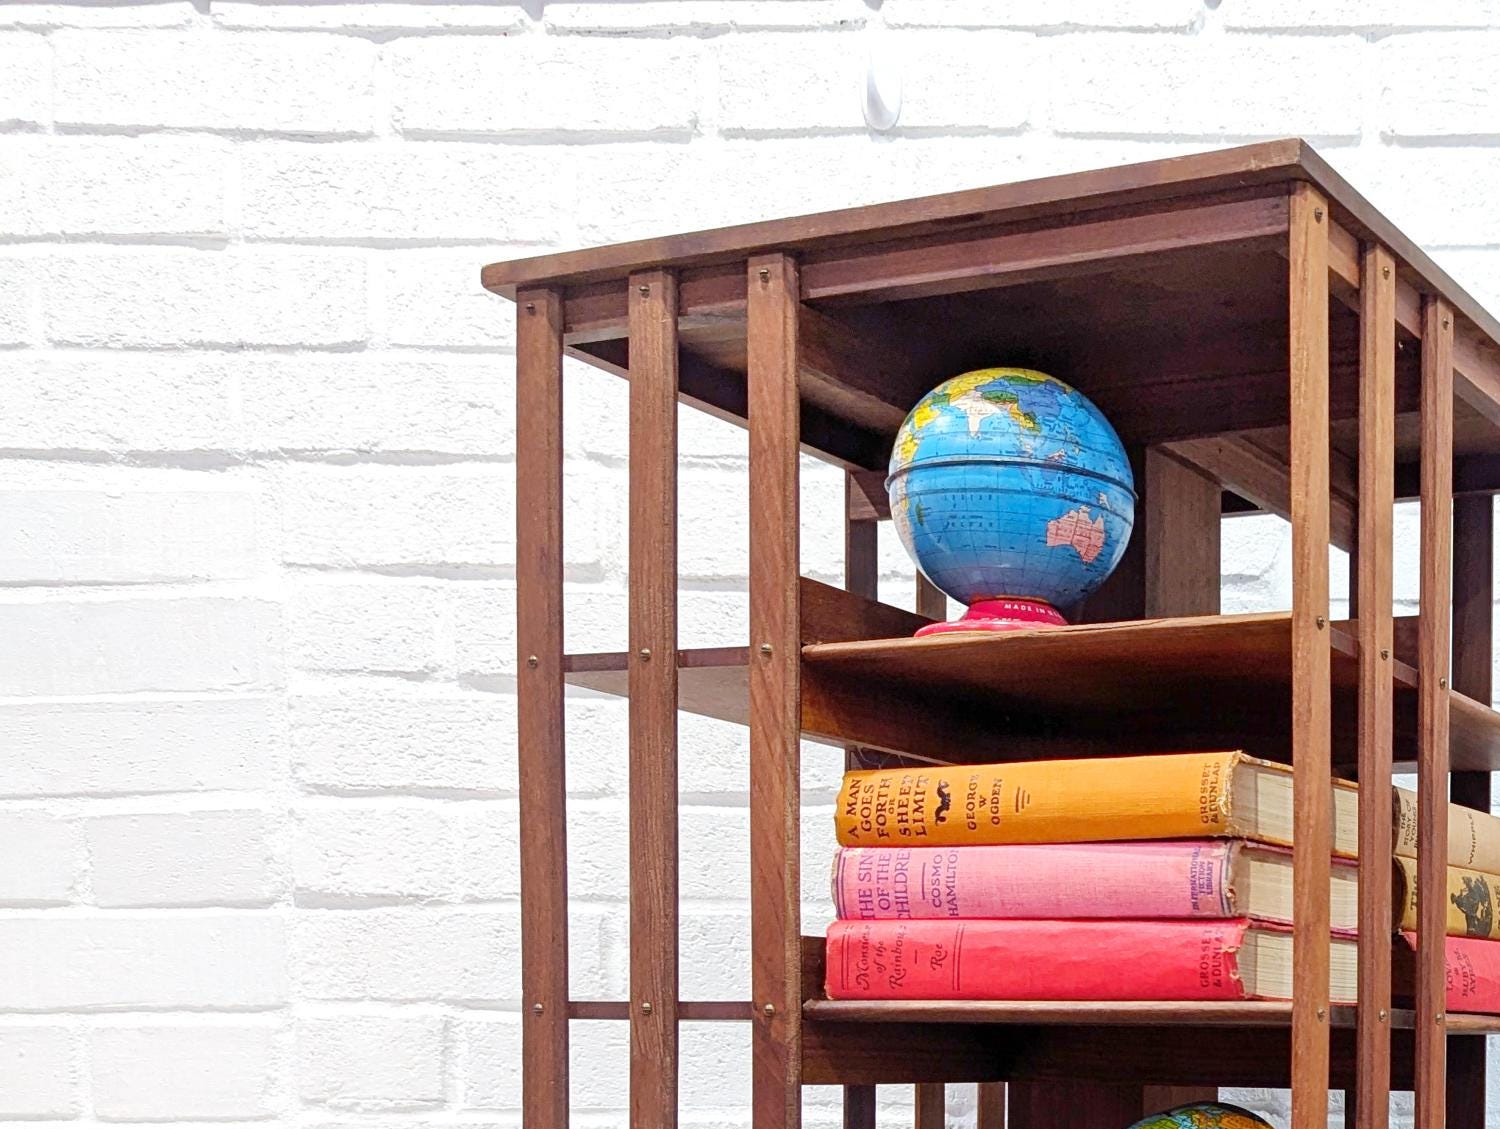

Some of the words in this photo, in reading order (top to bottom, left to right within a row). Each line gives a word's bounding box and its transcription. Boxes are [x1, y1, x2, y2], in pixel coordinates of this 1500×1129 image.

[1004, 603, 1032, 612] MADE
[846, 779, 862, 815] MAN
[966, 774, 979, 830] GEORGE
[979, 795, 988, 809] W
[990, 778, 1003, 825] OGDEN
[1199, 763, 1211, 824] GROSSET
[1209, 762, 1221, 812] DUNLAP
[860, 784, 875, 832] GOES
[875, 776, 893, 839] FORTH
[888, 799, 896, 815] OR
[897, 774, 915, 837] SHEEP
[913, 774, 930, 838] LIMIT
[848, 826, 859, 838] A
[876, 853, 892, 882] THE
[931, 853, 943, 908] COSMO
[858, 888, 875, 920] THE
[878, 887, 891, 911] OF
[873, 961, 887, 974] of
[876, 941, 887, 958] the
[930, 944, 948, 971] Roe
[1200, 930, 1213, 988] GROSSET
